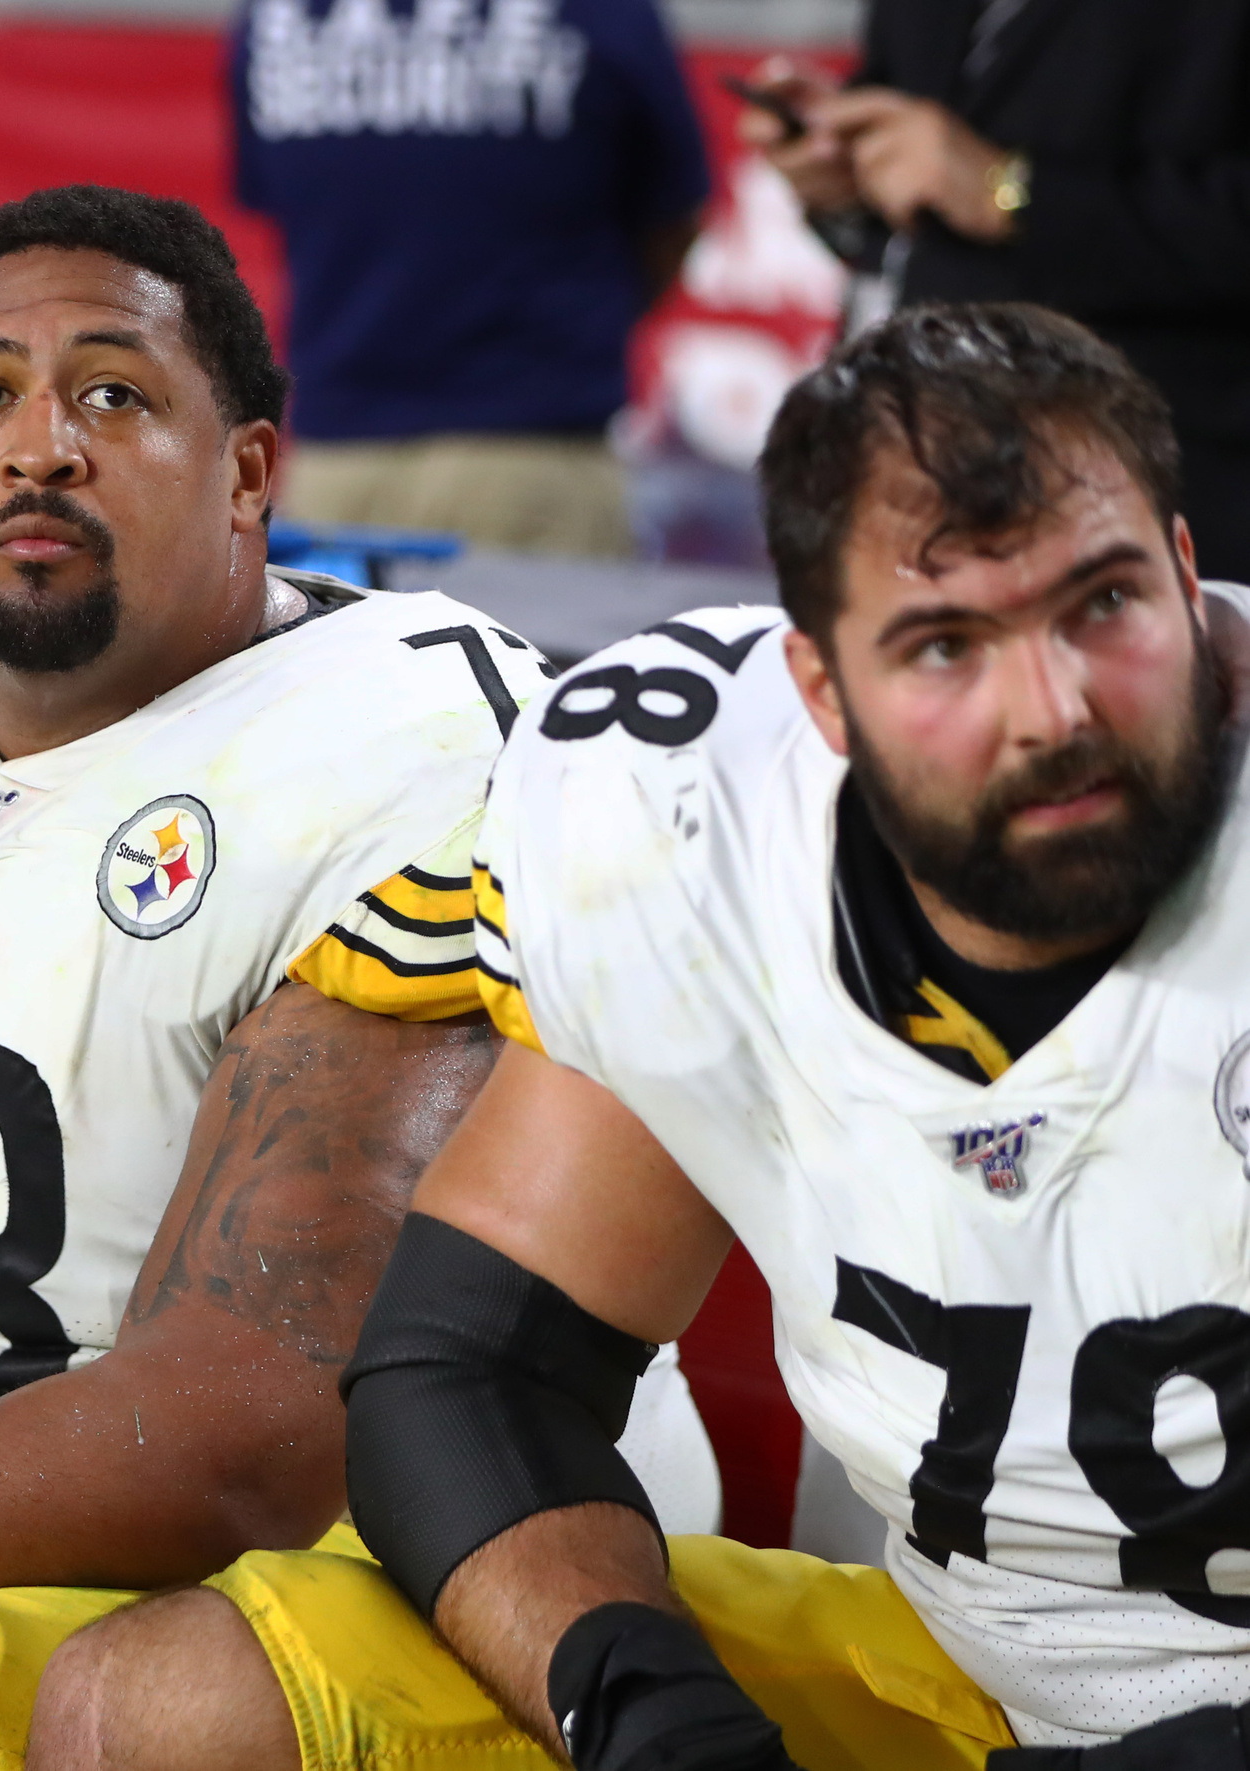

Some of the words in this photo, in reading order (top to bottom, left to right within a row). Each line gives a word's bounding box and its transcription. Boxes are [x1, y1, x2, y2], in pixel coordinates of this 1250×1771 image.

[249, 40, 586, 141] SECURITY
[116, 842, 156, 868] Steelers
[831, 1253, 1250, 1630] 78
